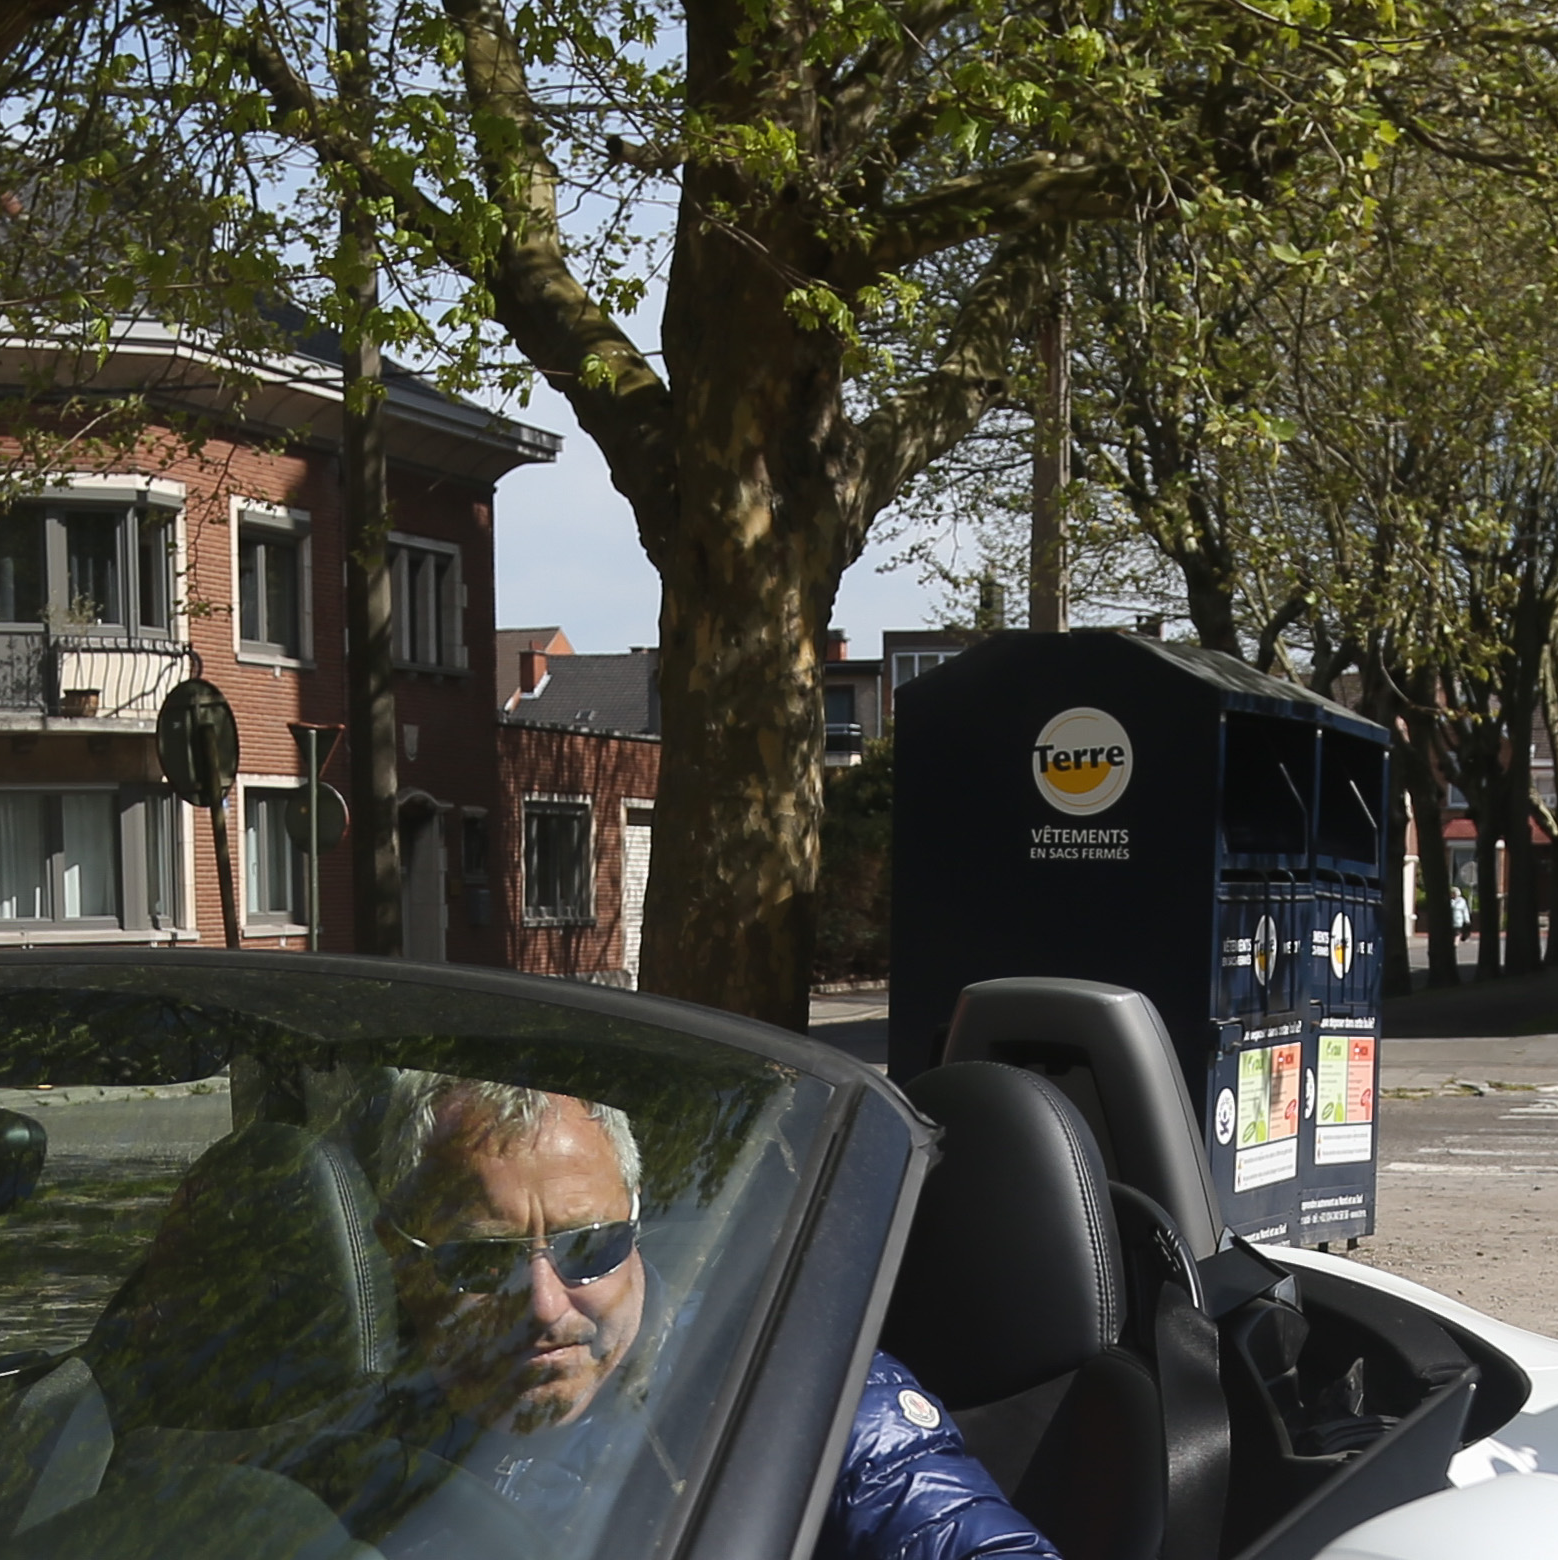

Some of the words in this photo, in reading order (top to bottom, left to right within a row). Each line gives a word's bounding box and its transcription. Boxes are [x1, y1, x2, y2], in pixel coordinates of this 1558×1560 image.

[1033, 743, 1125, 774] Terre
[1031, 825, 1130, 844] VÊTEMENTS
[1030, 847, 1046, 859] EN
[1049, 847, 1079, 859] SACS
[1082, 846, 1130, 860] FERMÉS
